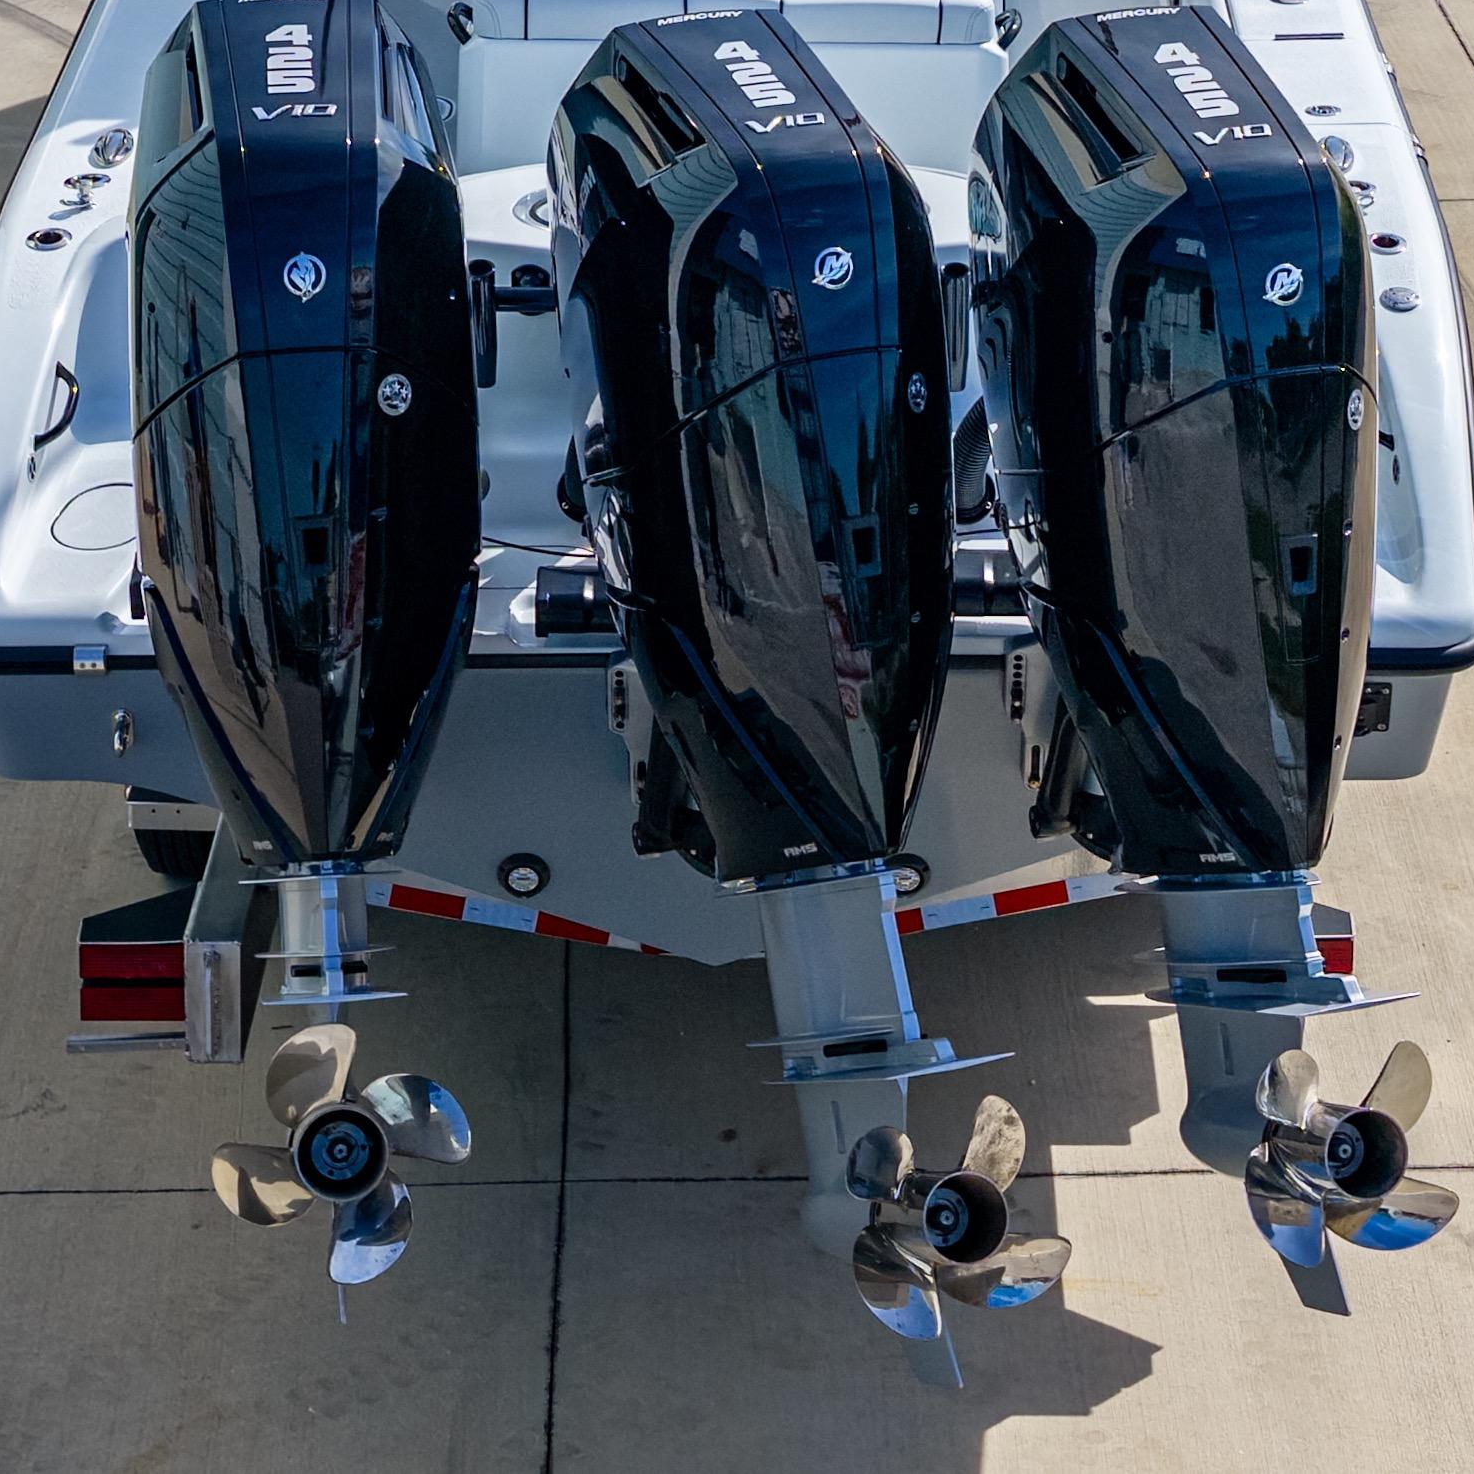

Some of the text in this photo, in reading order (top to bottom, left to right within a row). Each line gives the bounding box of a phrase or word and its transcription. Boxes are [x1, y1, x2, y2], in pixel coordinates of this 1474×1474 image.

[657, 10, 743, 27] MERCURY
[1097, 7, 1181, 23] MERCURY
[265, 24, 316, 95] 425
[713, 40, 797, 109] 425
[1153, 42, 1240, 119] 425
[251, 104, 338, 121] V10
[744, 112, 826, 134] V10
[1192, 123, 1273, 146] V10
